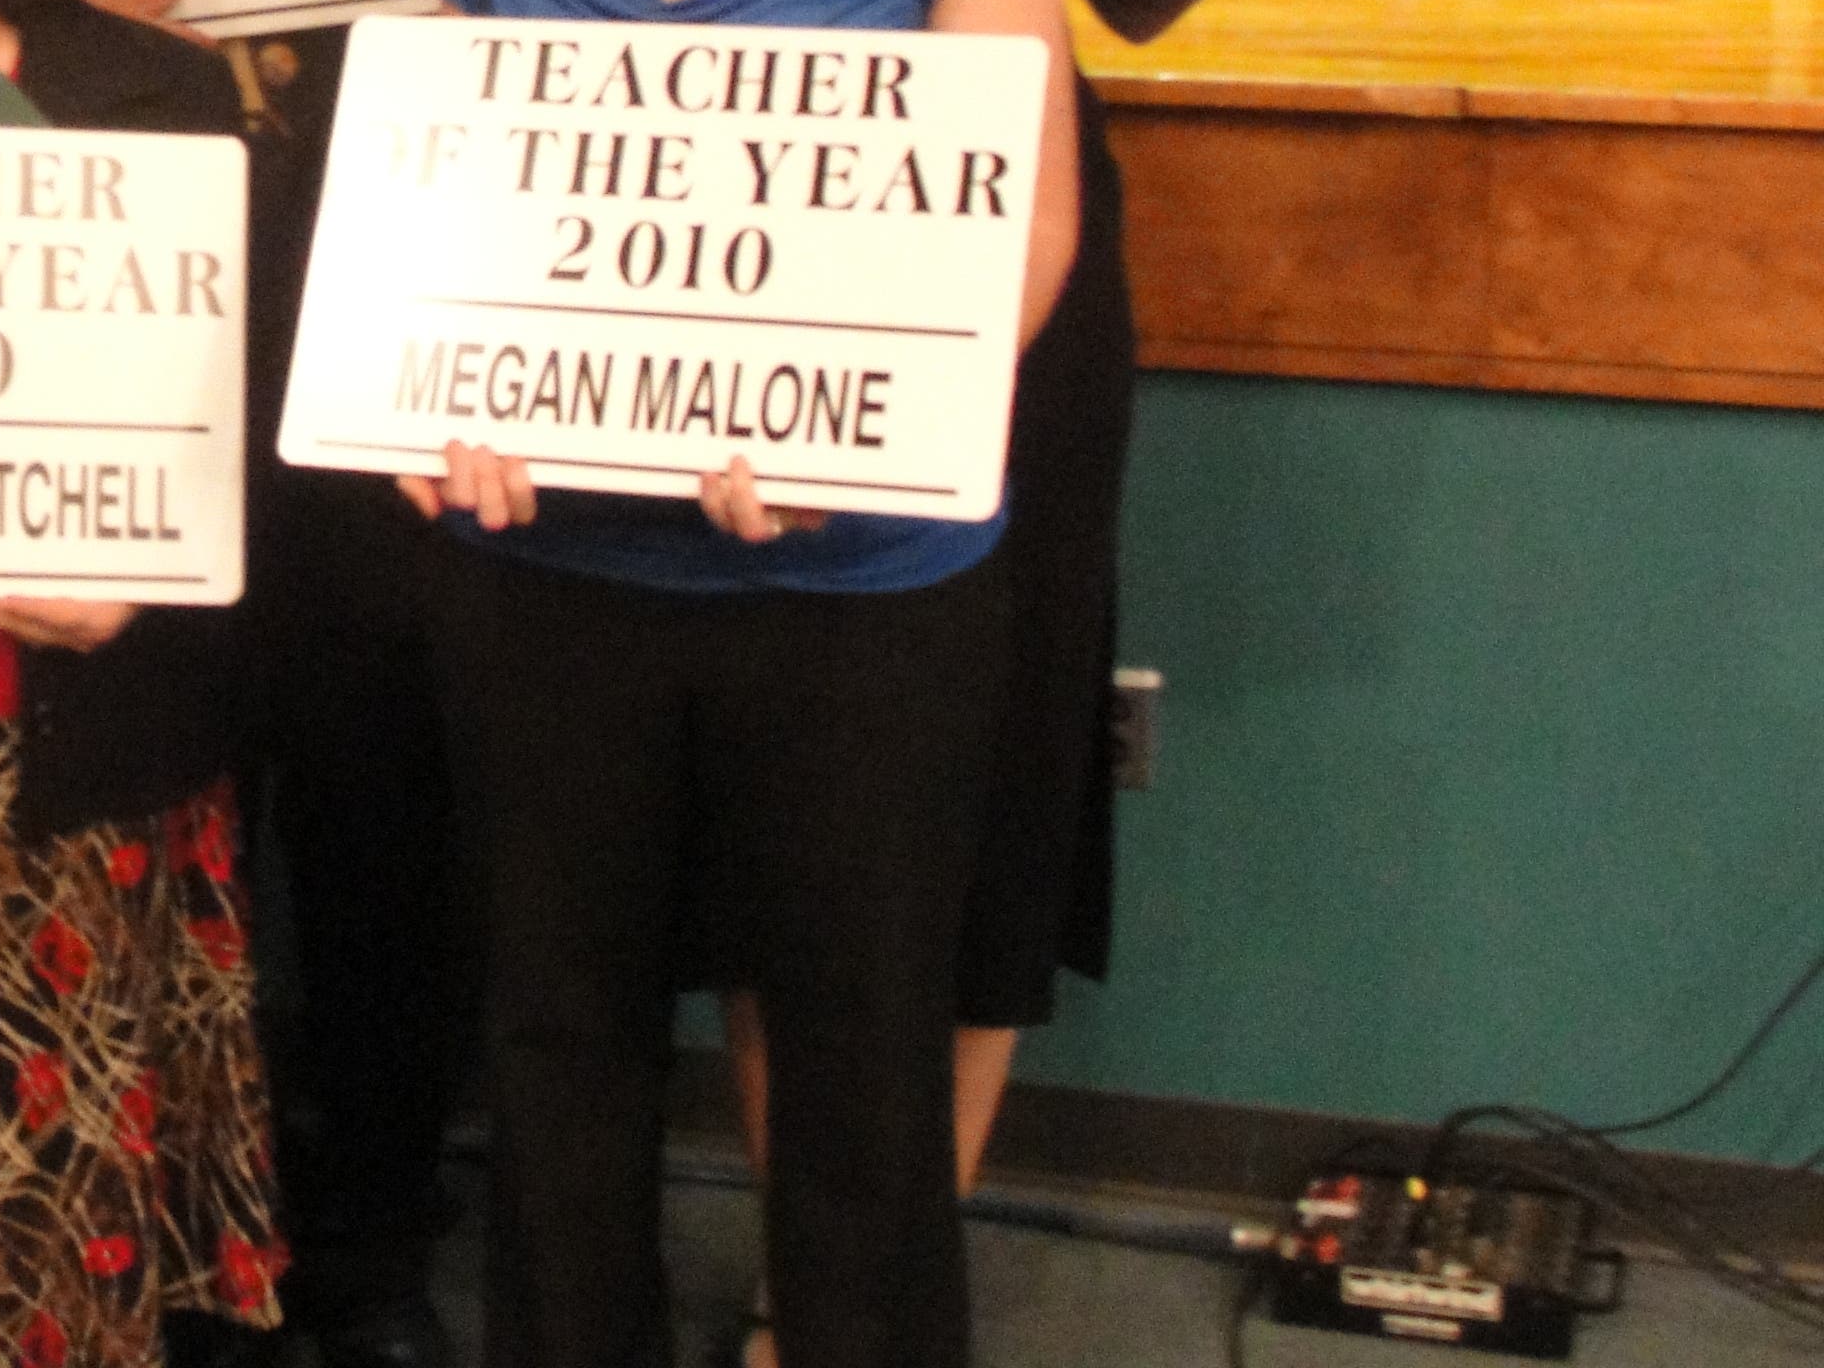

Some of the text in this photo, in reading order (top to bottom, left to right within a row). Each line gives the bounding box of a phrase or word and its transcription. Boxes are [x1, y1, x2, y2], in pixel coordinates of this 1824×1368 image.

[470, 37, 915, 121] TEACHER
[508, 126, 695, 202] THE
[740, 139, 1009, 219] YEAR
[547, 215, 772, 296] 2010
[394, 338, 893, 449] MEGAN MALONE
